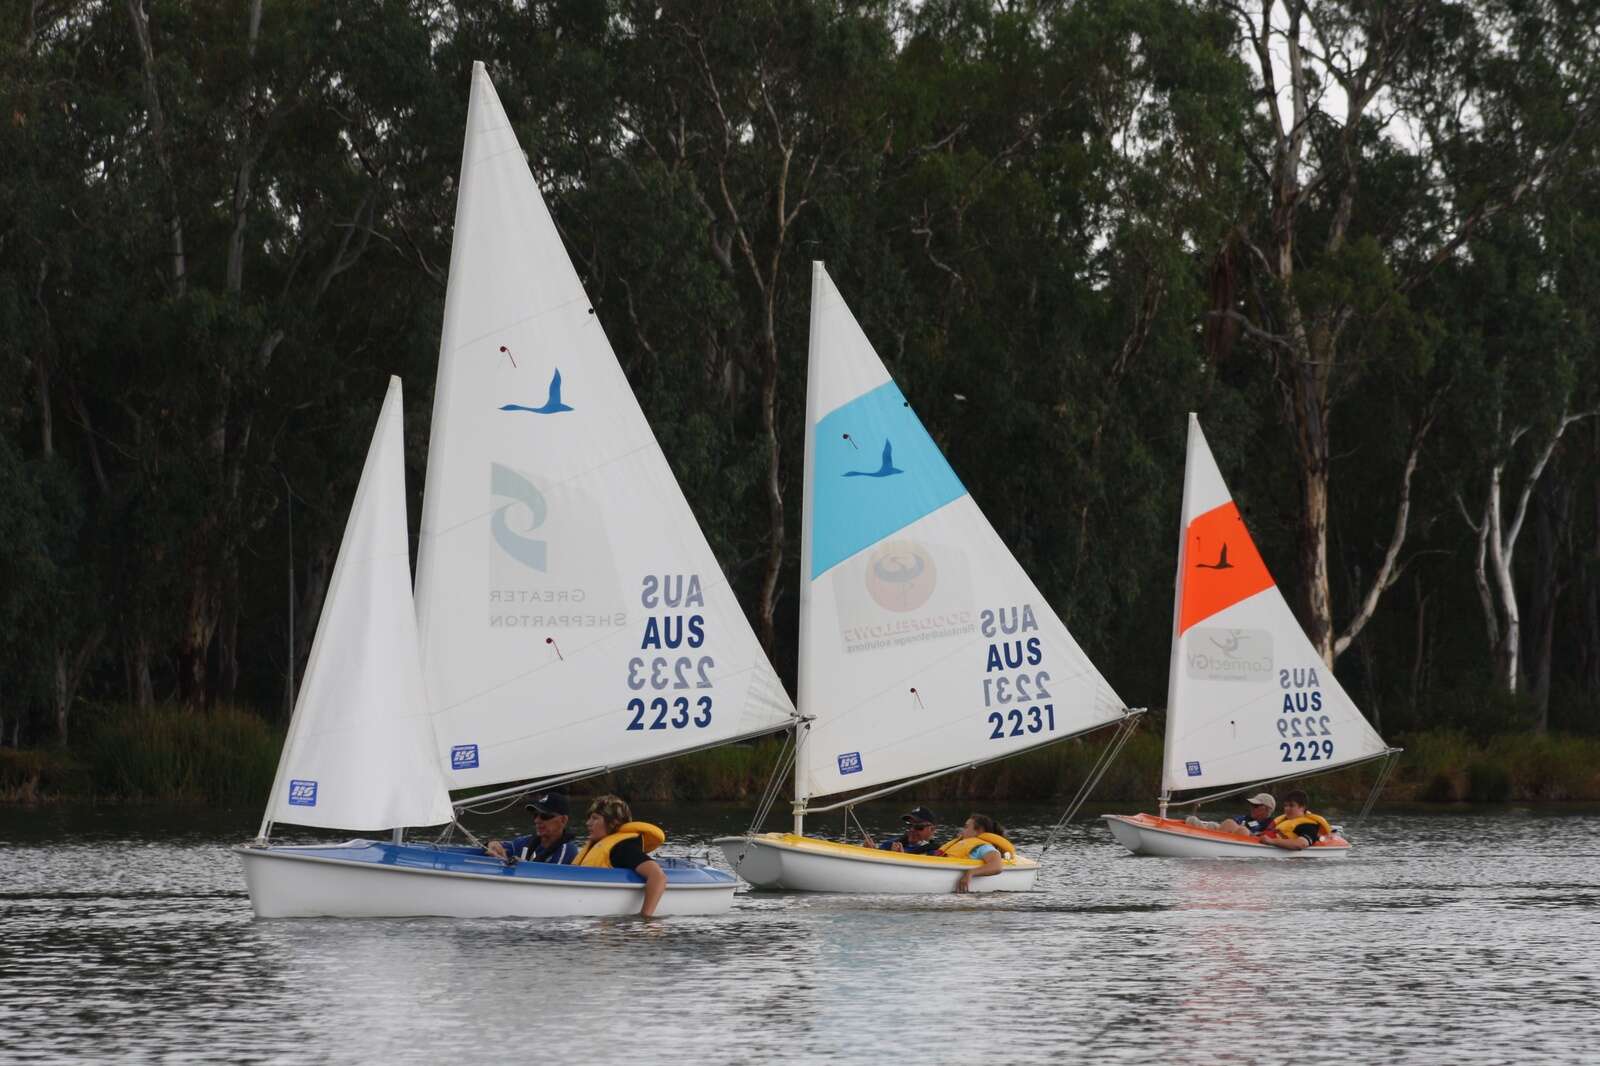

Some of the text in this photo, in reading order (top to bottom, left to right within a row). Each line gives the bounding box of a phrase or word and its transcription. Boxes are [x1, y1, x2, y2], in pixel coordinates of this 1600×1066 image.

[641, 615, 705, 650] AUS
[986, 637, 1042, 673] AUS
[626, 696, 713, 731] 2233
[1283, 691, 1322, 714] AUS
[988, 704, 1055, 740] 2231
[1279, 739, 1334, 762] 2229
